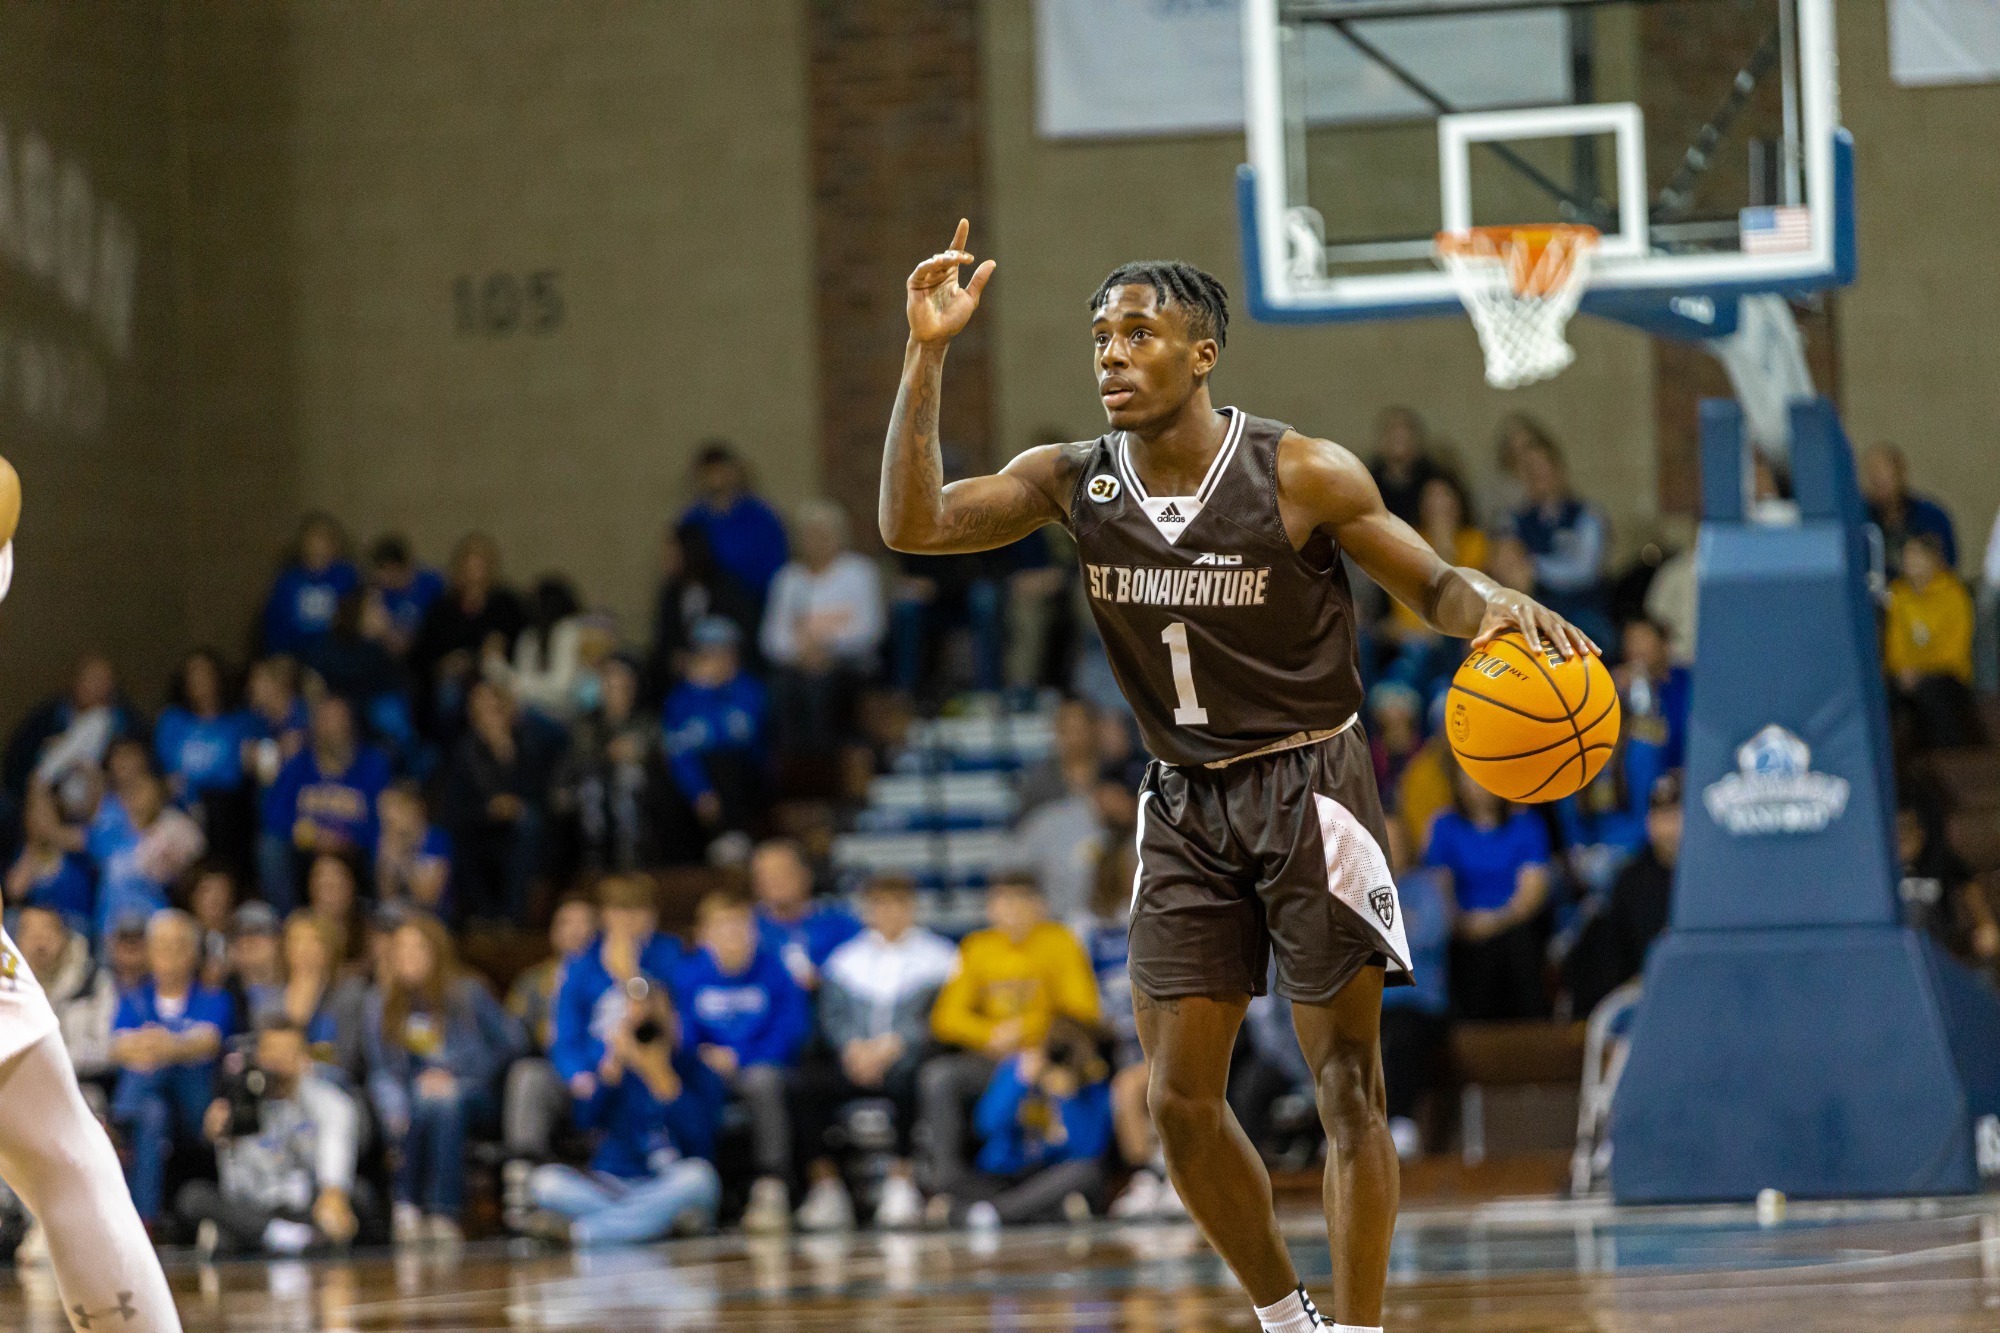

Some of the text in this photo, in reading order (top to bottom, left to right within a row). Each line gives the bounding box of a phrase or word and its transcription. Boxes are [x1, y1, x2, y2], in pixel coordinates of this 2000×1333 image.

[1091, 479, 1117, 498] 31
[1157, 514, 1186, 523] adidas
[1086, 563, 1270, 606] ST. BONAVENTURE
[1161, 622, 1209, 726] 1
[1463, 651, 1530, 682] EVO NXT
